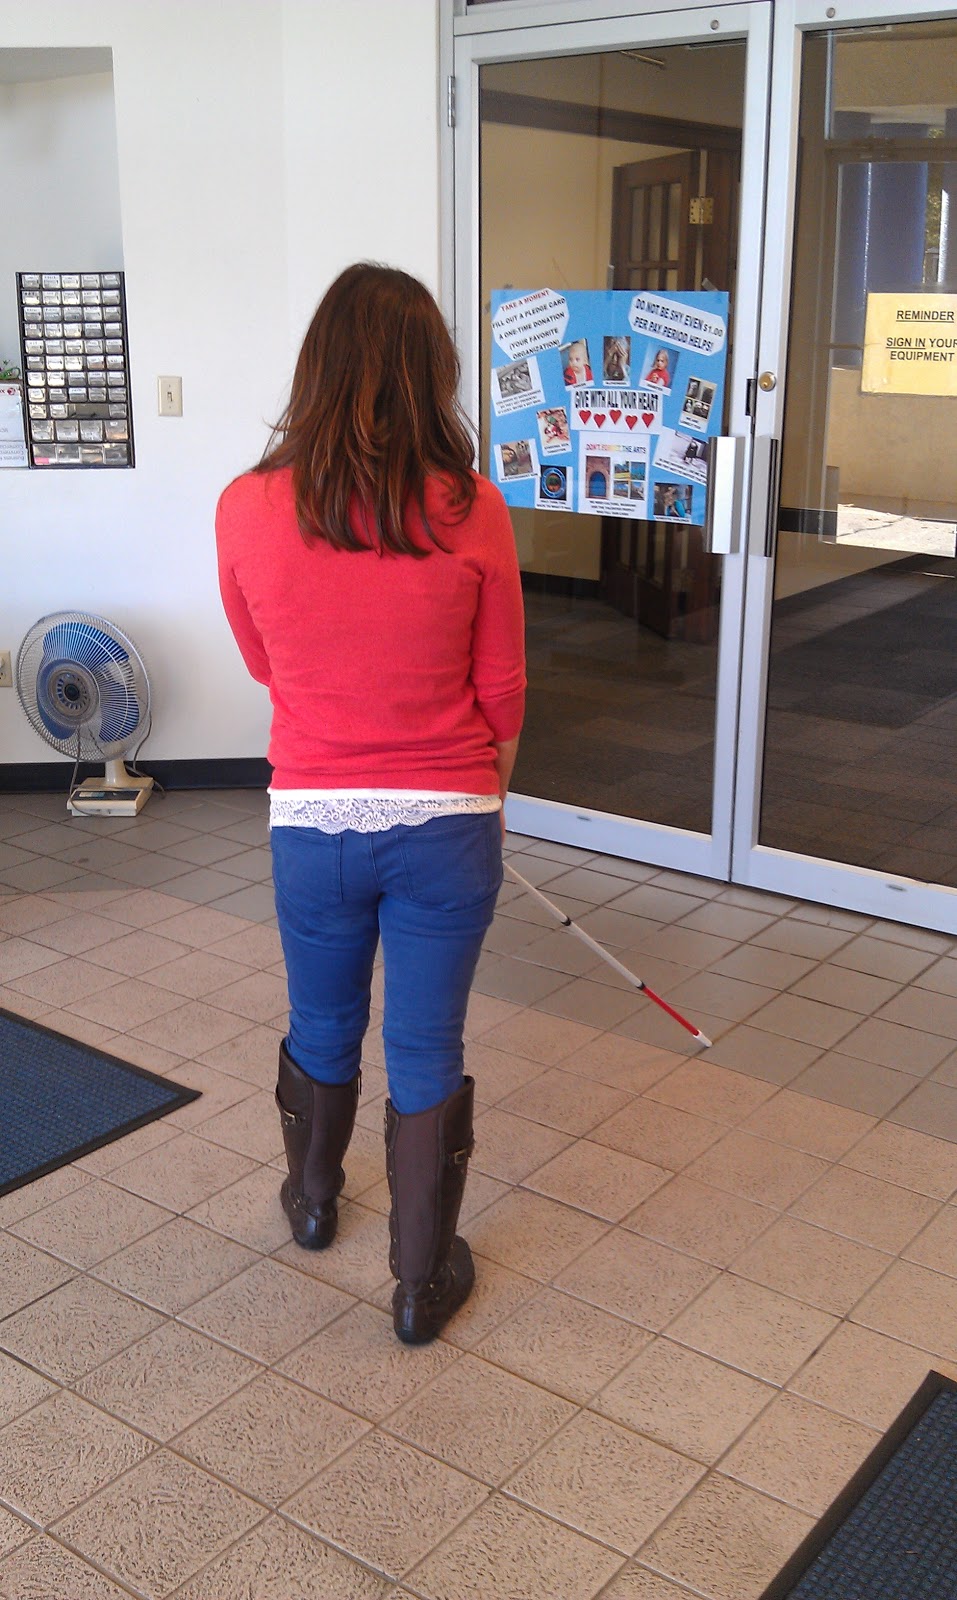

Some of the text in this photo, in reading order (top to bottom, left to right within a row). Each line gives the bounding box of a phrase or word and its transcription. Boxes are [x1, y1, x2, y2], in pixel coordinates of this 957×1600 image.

[501, 302, 518, 312] TAKE
[524, 290, 549, 303] MOMENT
[492, 320, 505, 329] FILL
[506, 315, 518, 324] OUT
[525, 305, 547, 317] PLEDGE
[549, 298, 566, 308] CARD
[533, 311, 565, 328] DONATION
[635, 298, 723, 337] DO NOT BE SHY EVEN $1.00
[896, 310, 955, 321] REMINDER
[509, 328, 559, 350] (YOUR FAVORITE
[634, 316, 714, 352] PER PAY PERIOD HELPS!
[886, 337, 957, 348] SIGN IN YOUR
[513, 340, 560, 359] ORGANIZATION)
[890, 351, 955, 361] EQUIPMENT
[575, 390, 659, 412] GIVE WITH ALL YOUR HEART
[633, 446, 646, 454] ARTS
